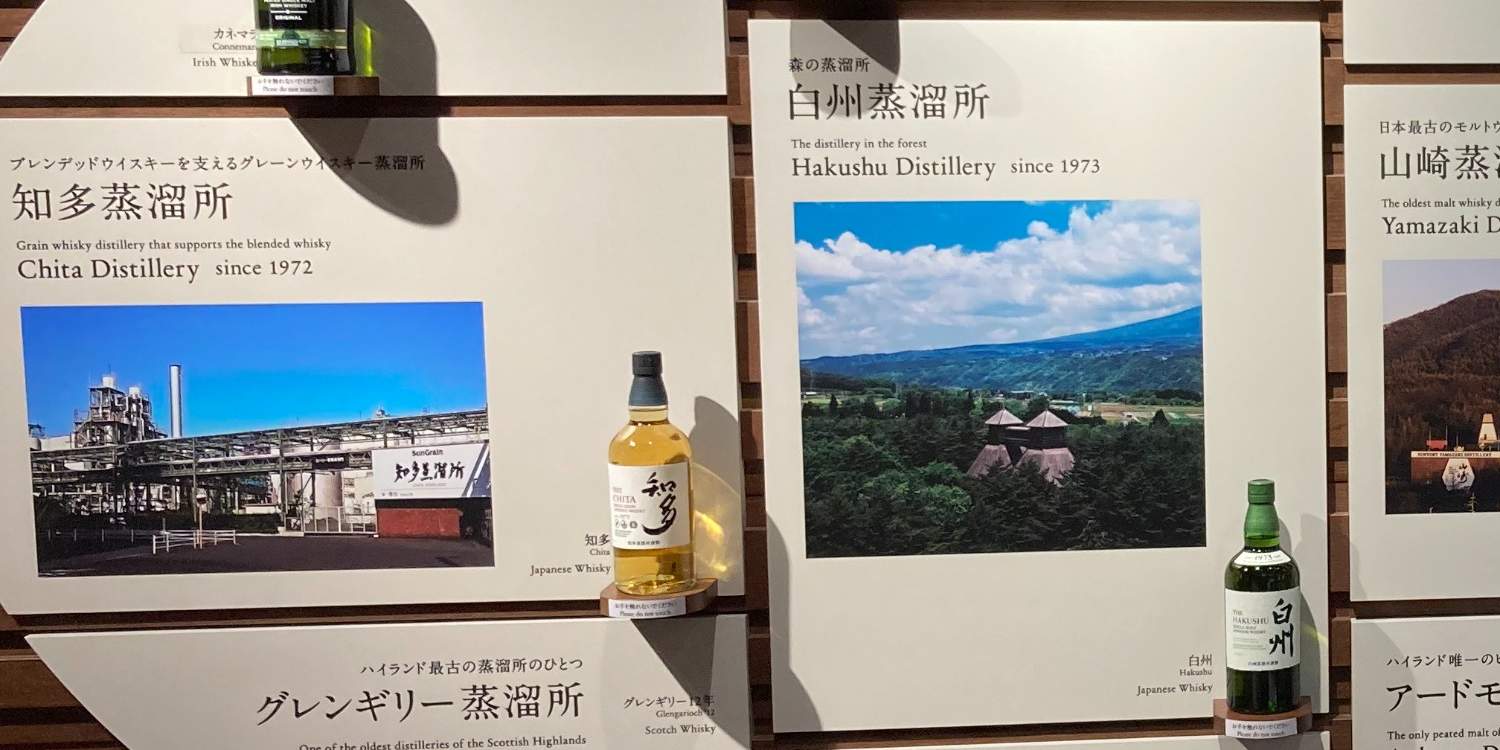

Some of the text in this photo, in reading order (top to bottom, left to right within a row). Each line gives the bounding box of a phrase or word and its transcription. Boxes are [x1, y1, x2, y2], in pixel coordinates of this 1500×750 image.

[192, 57, 216, 66] Irish
[789, 57, 870, 72] 森の蒸溜所
[789, 83, 990, 120] 白州蒸溜所
[791, 138, 927, 151] The distillery in the forest
[11, 155, 424, 171] ブレンデッドウイスキーを支えるグレーンウイスキー蒸溜所
[792, 156, 1100, 181] Hakushu Distillery since 1973
[13, 183, 232, 220] 知多蒸溜所
[1381, 199, 1400, 208] The
[1403, 198, 1431, 207] oldest
[1434, 198, 1455, 207] malt
[1458, 198, 1492, 209] whisky
[1382, 215, 1479, 234] Yamazaki
[17, 238, 331, 252] Grain whisky distillery that supports the blended whisky
[18, 258, 312, 283] Chita Distillery since 1972
[641, 472, 677, 535] 知多
[585, 534, 610, 546] 知多
[589, 547, 610, 555] Chita
[530, 564, 611, 576] Japanese Whisky
[1269, 598, 1293, 657] 白州
[361, 658, 582, 676] ハイランド最古の蒸溜所のひとつ
[1189, 654, 1212, 667] 白州
[1180, 668, 1212, 676] Hakushu
[1137, 683, 1213, 696] Japanese Whisky
[258, 682, 584, 725] グレンギリー蒸溜所
[624, 695, 714, 710] グレンギリー12年
[645, 724, 716, 735] Scotch Whisky
[1387, 731, 1406, 740] The
[1409, 730, 1430, 742] only
[1433, 729, 1464, 741] peated
[1468, 728, 1489, 737] malt
[360, 735, 586, 750] oldest distilleries of the Scottish Highlands
